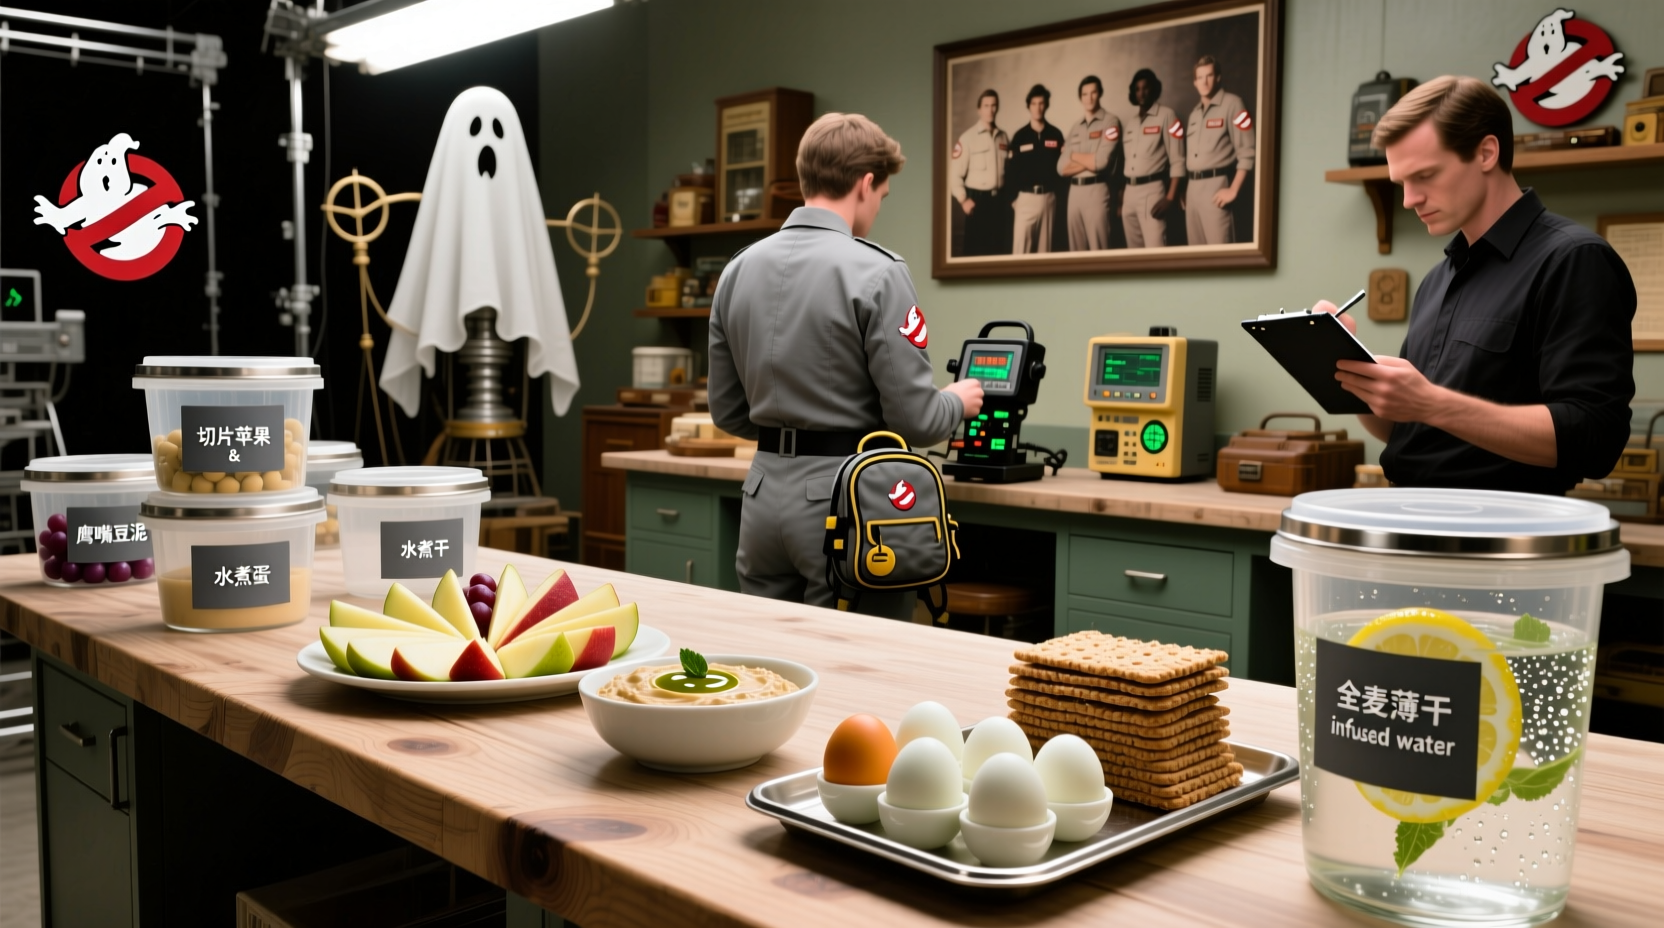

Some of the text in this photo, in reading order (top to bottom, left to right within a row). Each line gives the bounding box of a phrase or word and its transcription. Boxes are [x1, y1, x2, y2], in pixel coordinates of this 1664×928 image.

[196, 425, 271, 447] 切片苹果
[228, 448, 241, 462] &
[400, 539, 450, 559] 水煮干
[213, 565, 272, 587] 水煮蛋
[1337, 680, 1452, 727] 全麦薄干
[1330, 715, 1456, 756] infused water
